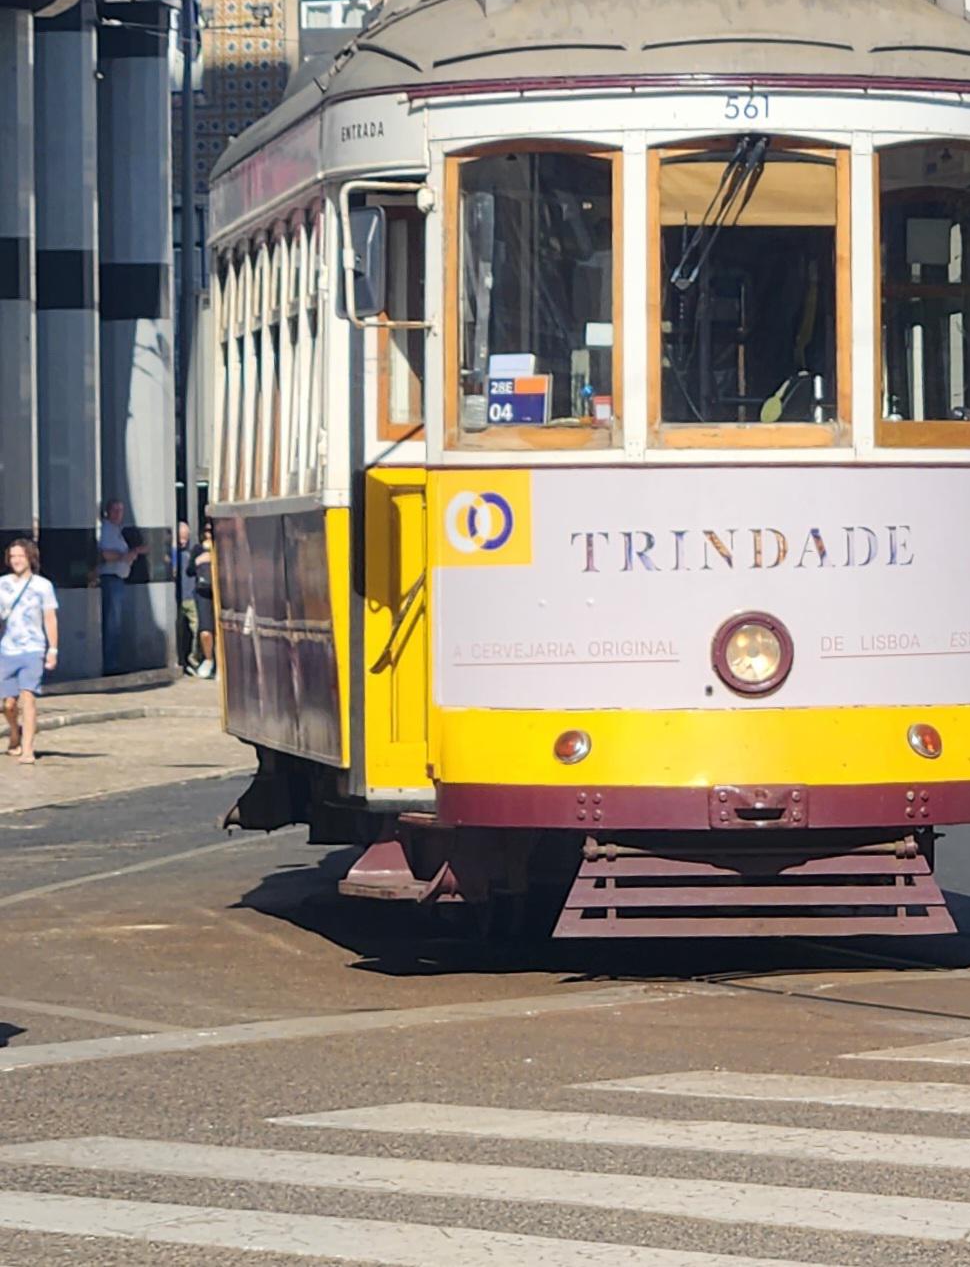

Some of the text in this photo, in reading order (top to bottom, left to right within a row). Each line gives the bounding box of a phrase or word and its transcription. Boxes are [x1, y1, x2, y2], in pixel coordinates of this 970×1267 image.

[724, 94, 770, 120] 561
[341, 121, 384, 143] ENTRADA
[490, 381, 513, 394] 28E
[489, 402, 514, 421] 04
[571, 525, 915, 573] TRINDADE
[453, 639, 679, 659] A CERVEJARIA ORIGINAL
[820, 635, 844, 652] DE
[860, 633, 921, 651] LISBOA
